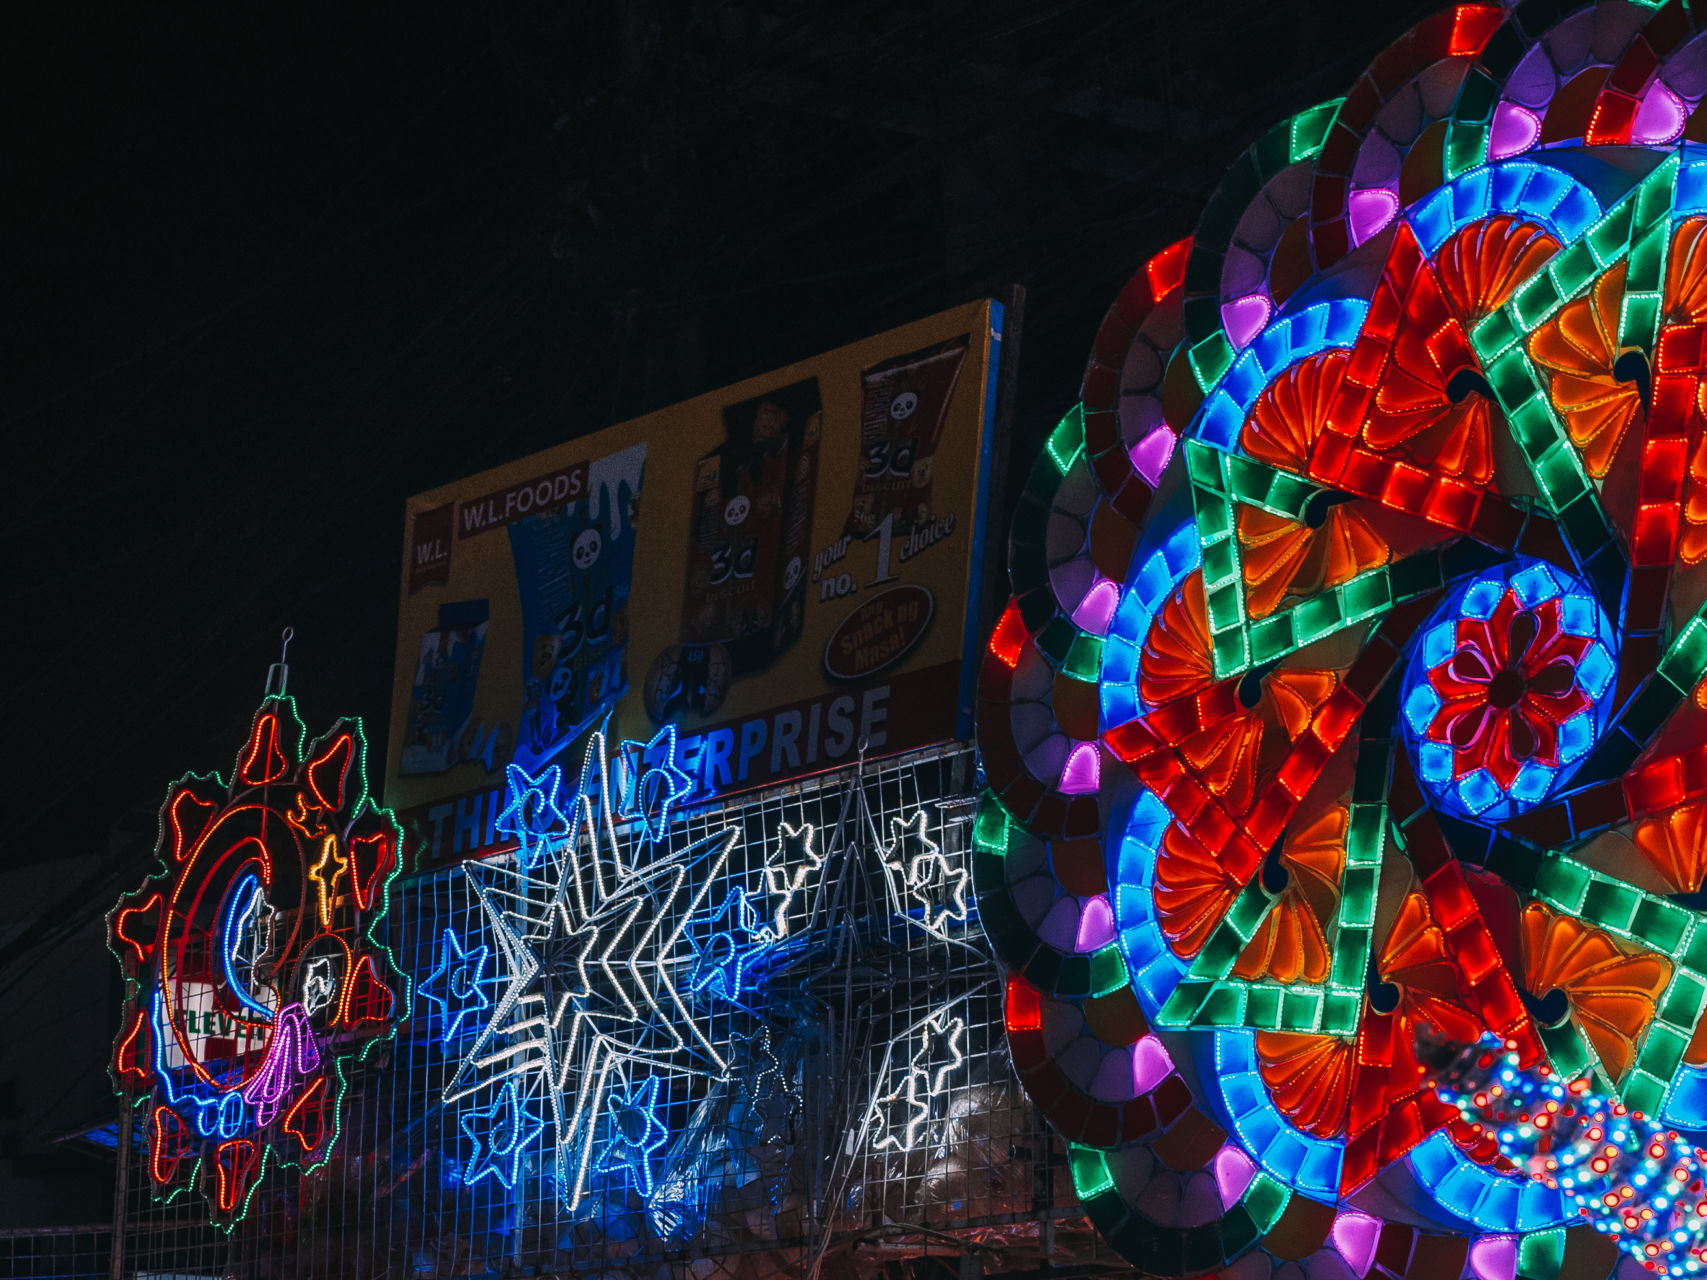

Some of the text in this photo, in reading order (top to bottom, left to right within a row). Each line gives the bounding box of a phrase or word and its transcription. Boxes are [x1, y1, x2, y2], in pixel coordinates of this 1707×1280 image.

[416, 538, 449, 566] W.L.
[812, 512, 956, 602] your no. 1 choice
